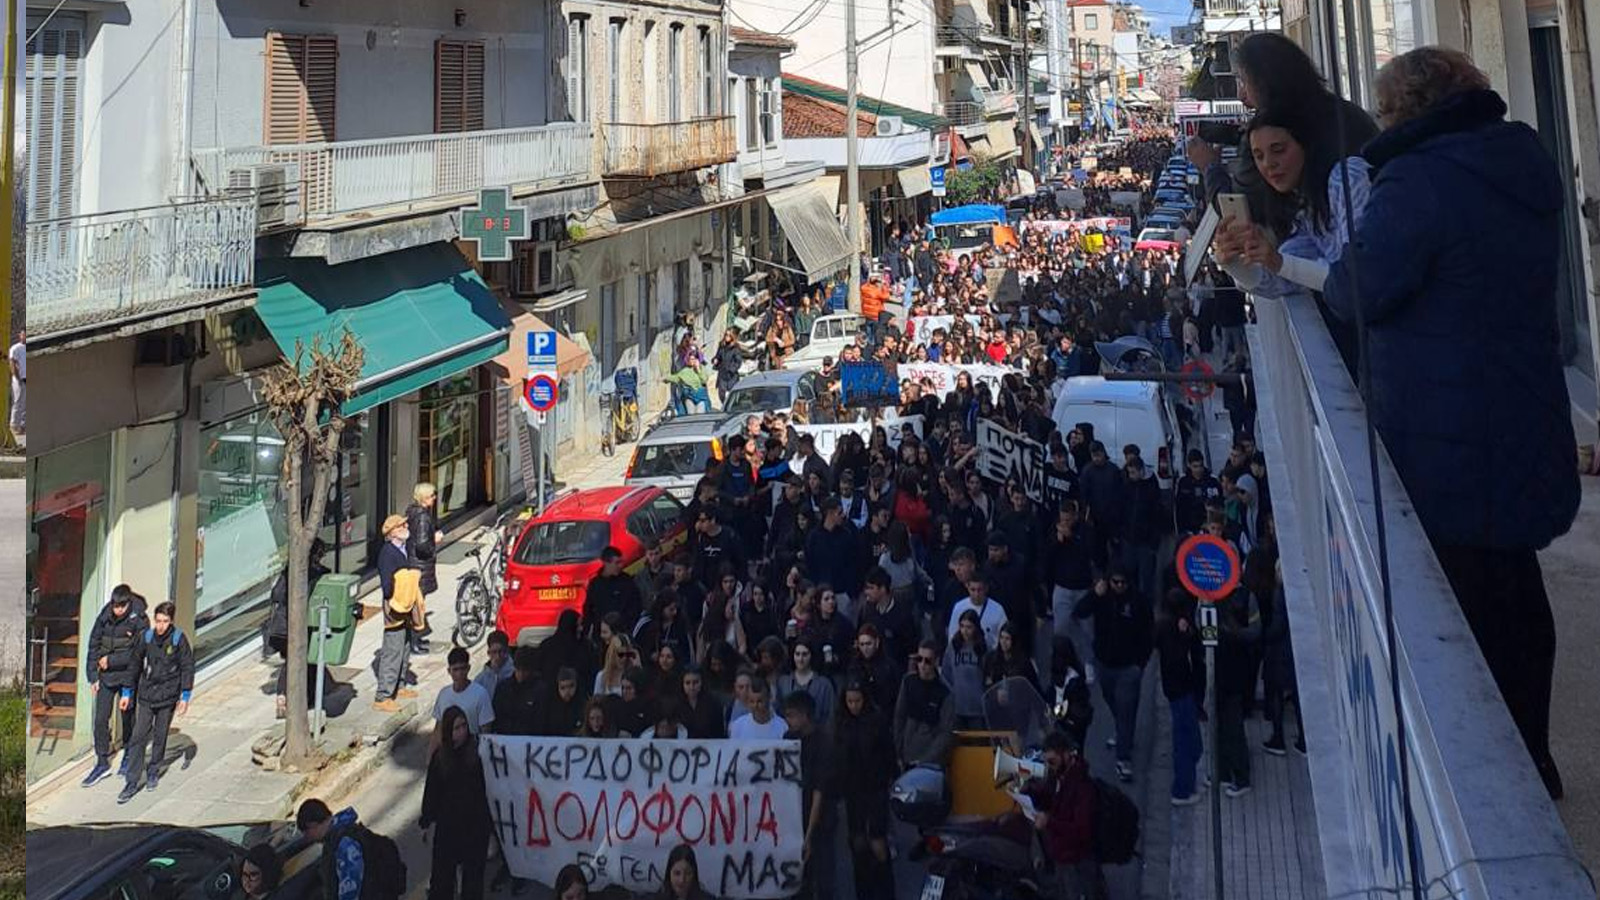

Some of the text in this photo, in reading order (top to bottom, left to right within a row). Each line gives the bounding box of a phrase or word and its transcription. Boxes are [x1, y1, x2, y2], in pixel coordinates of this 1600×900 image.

[534, 332, 550, 355] P
[986, 426, 1045, 470] ΠΟΤΕ
[488, 741, 801, 788] Η ΚΕΡΔΟΦΟΡΙΑ ΣΑΣ
[494, 783, 779, 848] Η ΔΟΛΟΦΟΝΙΑ
[720, 851, 801, 895] ΜΑΣ
